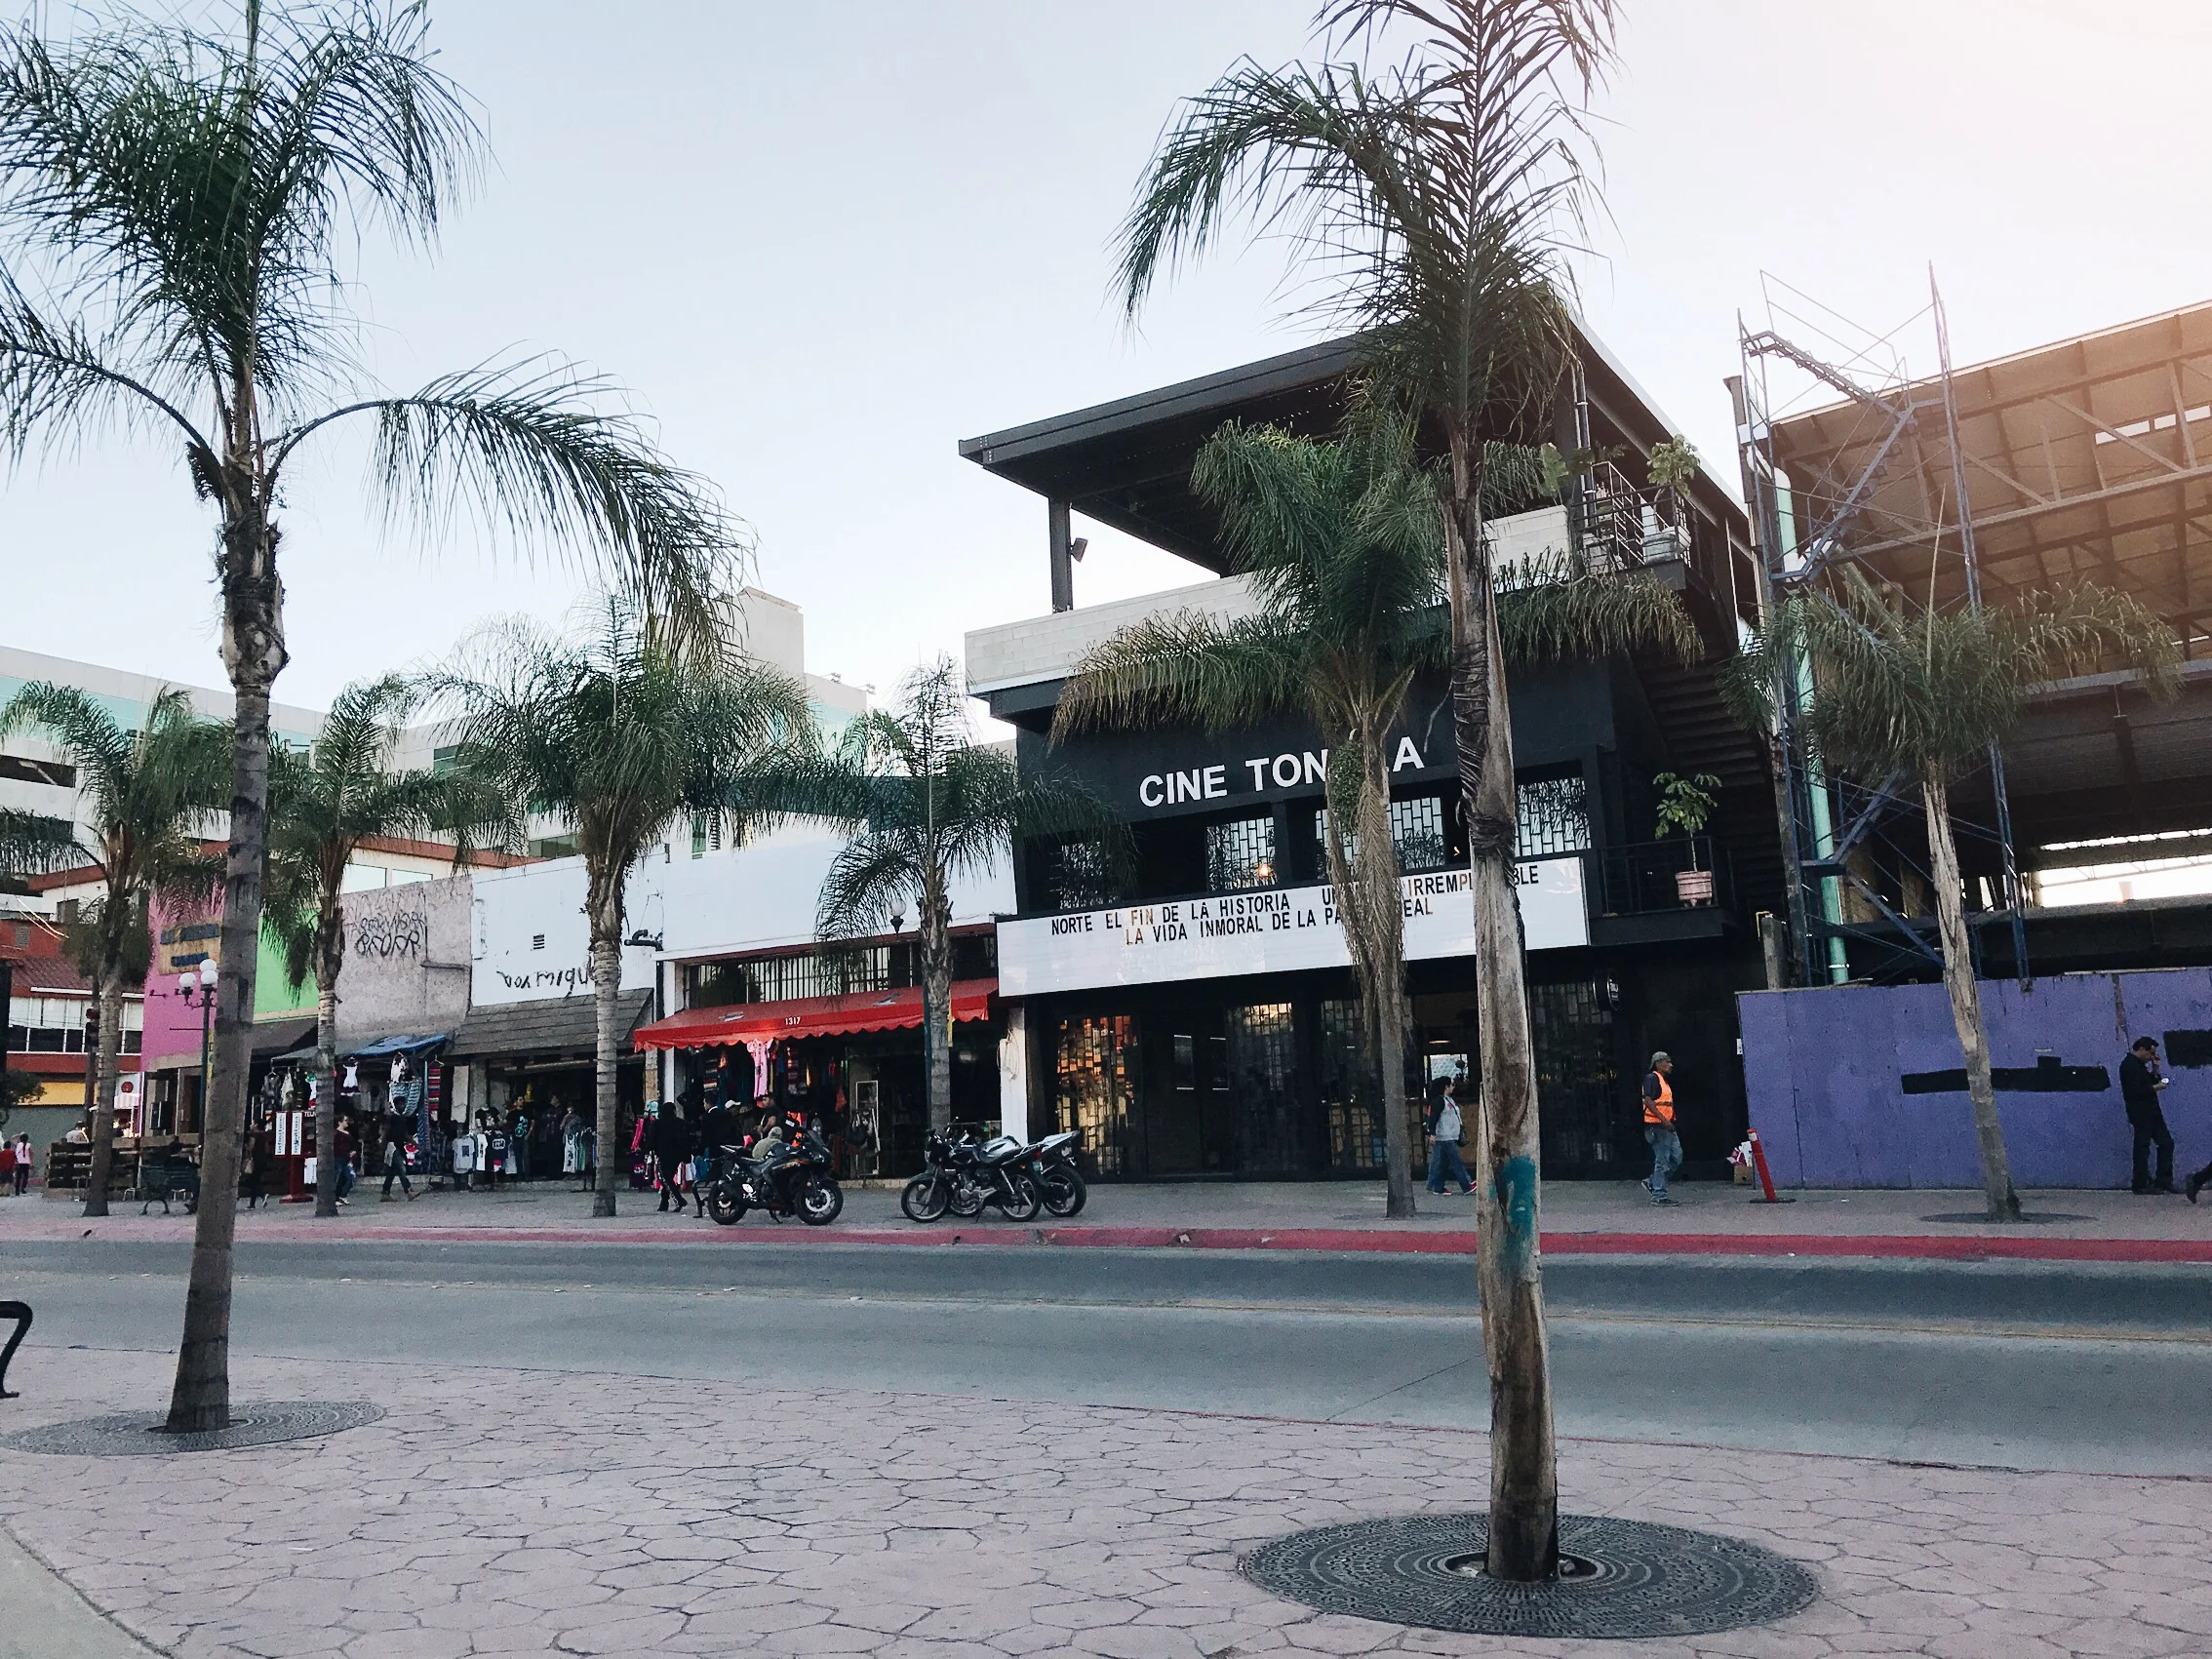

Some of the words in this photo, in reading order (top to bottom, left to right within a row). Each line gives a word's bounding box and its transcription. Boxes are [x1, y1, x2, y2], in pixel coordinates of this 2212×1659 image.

[1139, 764, 1228, 809] CINE
[1244, 735, 1425, 792] TONA
[1051, 915, 1093, 936] NORTE
[1105, 911, 1122, 929] EL
[1130, 908, 1154, 927] FIN
[1163, 905, 1179, 924] DE
[1191, 901, 1209, 921] LA
[1219, 892, 1290, 918] HISTORIA
[1407, 864, 1539, 896] IRREMPLBLE
[1126, 928, 1144, 946] LA
[1153, 923, 1188, 943] VIDA
[1200, 915, 1264, 938] INMORAL
[1272, 911, 1291, 930] DE
[1297, 909, 1317, 928] LA
[1403, 897, 1434, 918] EAL
[785, 1016, 801, 1025] 1317
